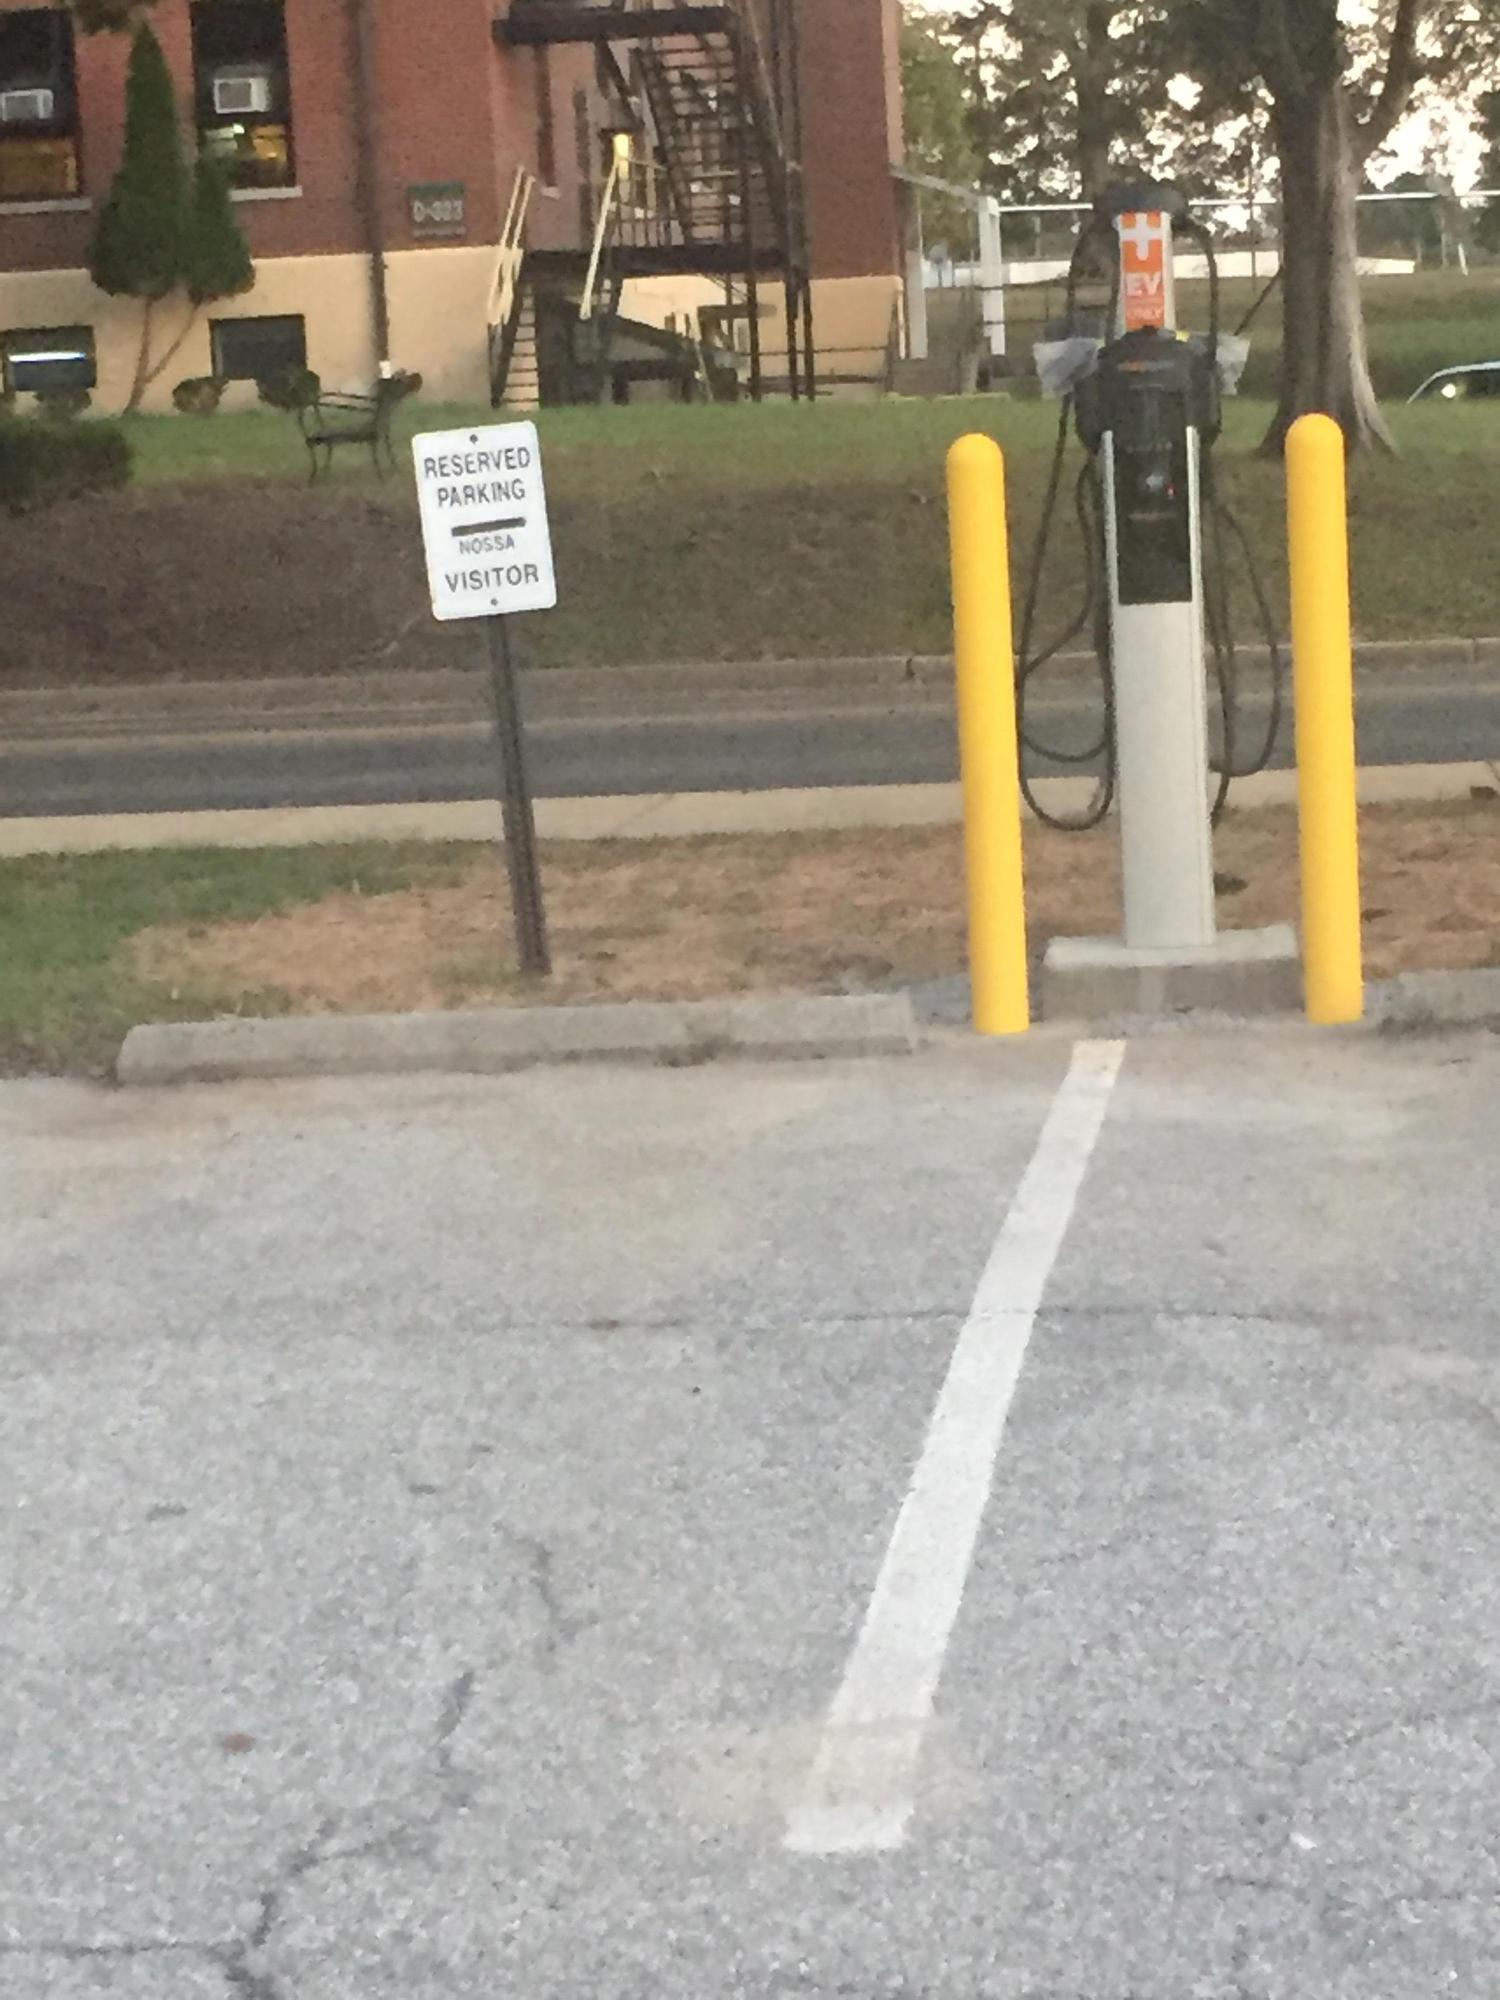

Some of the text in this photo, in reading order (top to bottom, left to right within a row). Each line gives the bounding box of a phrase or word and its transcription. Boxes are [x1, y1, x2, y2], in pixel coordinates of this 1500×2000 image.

[1126, 272, 1161, 296] EV
[424, 447, 530, 479] RESERVED
[437, 479, 525, 508] PARKING
[459, 535, 515, 554] NOSSA
[445, 563, 539, 593] VISITOR
